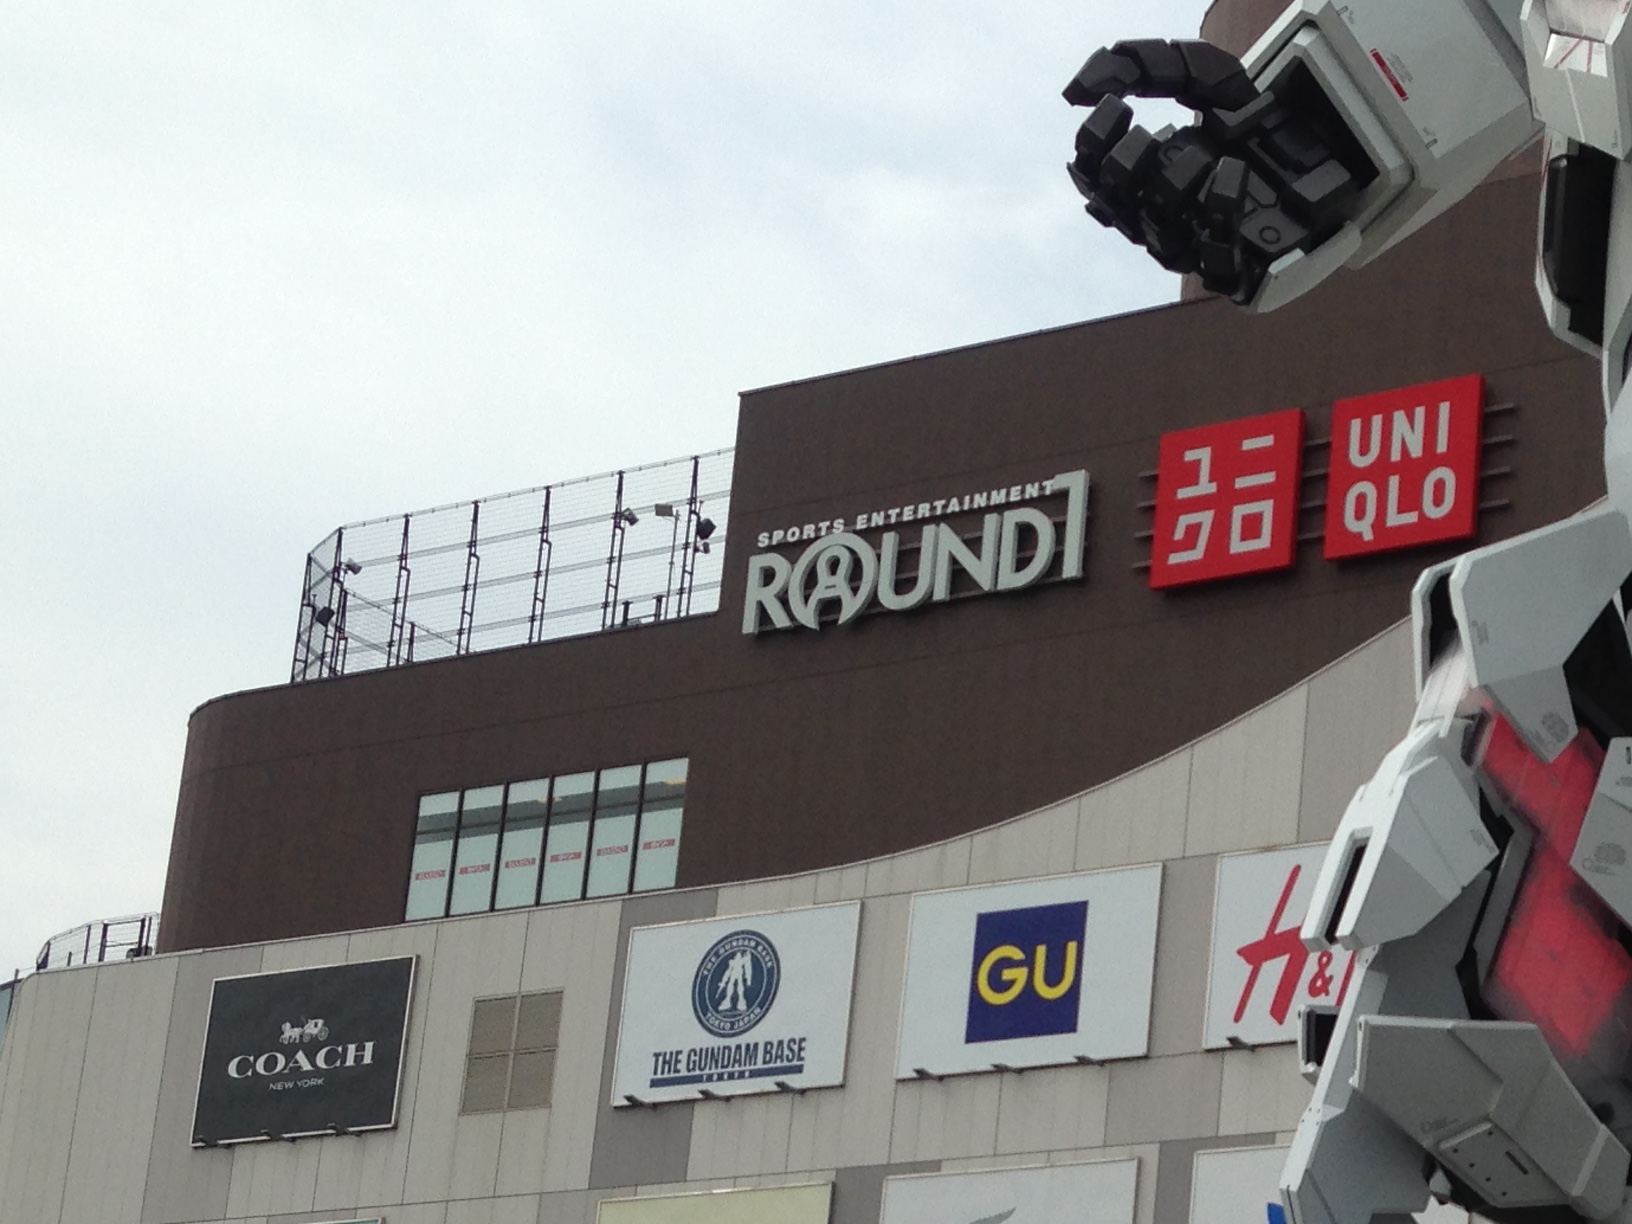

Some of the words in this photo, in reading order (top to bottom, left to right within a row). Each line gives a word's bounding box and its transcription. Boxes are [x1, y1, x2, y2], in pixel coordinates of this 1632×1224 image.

[1177, 434, 1276, 499] ユニ
[1349, 401, 1451, 468] UNI
[756, 517, 846, 548] SPORTS
[855, 478, 1056, 530] ENTERTAINMENT
[1167, 499, 1274, 565] クロ
[1343, 466, 1457, 541] QLO
[976, 940, 1078, 1006] GU
[1233, 864, 1357, 1025] H&
[733, 1006, 762, 1030] JAPAN
[227, 1041, 376, 1078] COACH
[268, 1080, 295, 1091] NEW
[297, 1077, 326, 1089] YORK
[652, 1049, 684, 1076] THE
[685, 1041, 759, 1073] GUNDAM
[762, 1037, 807, 1065] BASE
